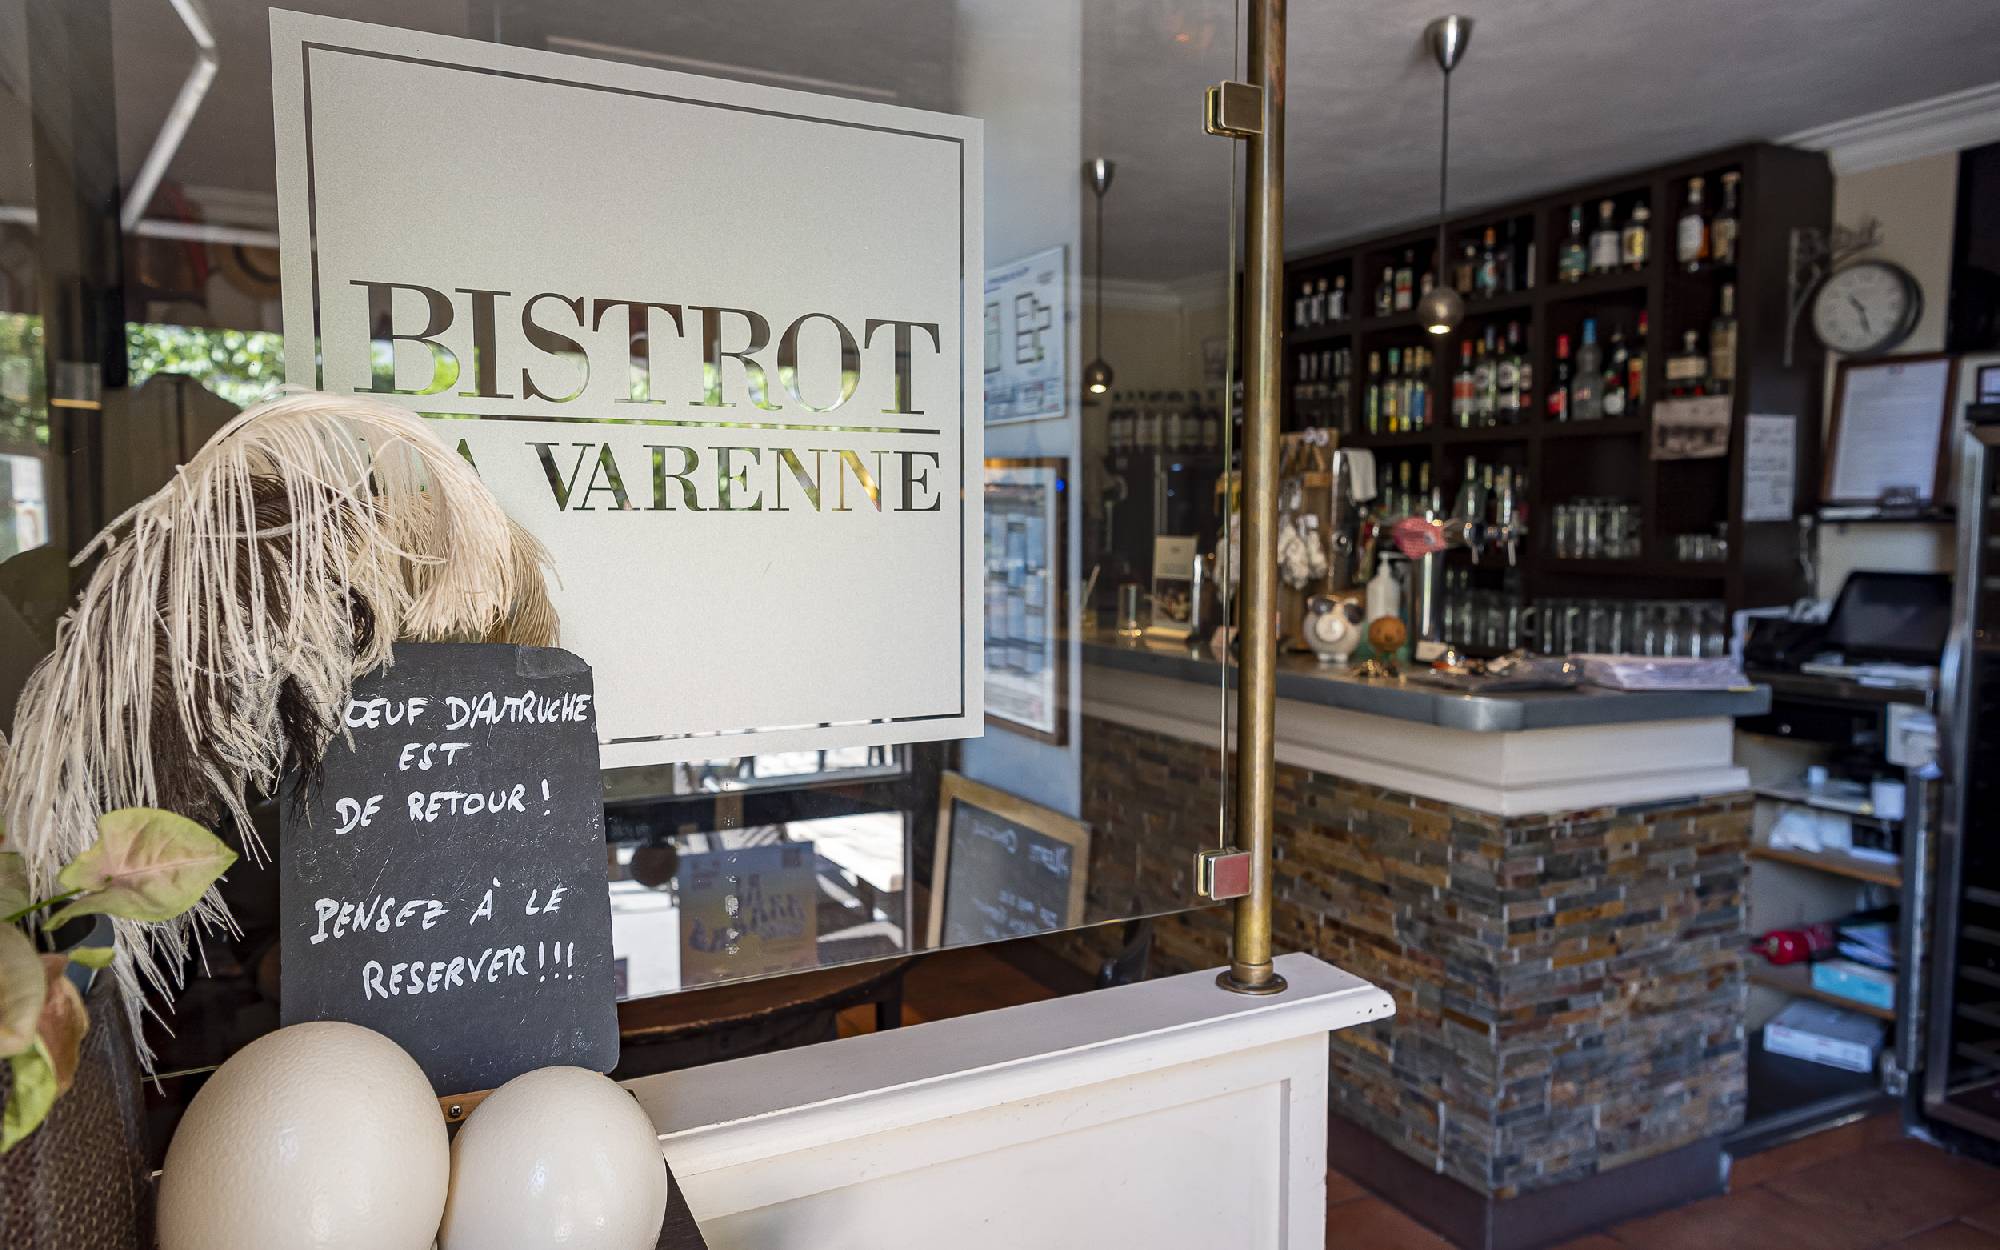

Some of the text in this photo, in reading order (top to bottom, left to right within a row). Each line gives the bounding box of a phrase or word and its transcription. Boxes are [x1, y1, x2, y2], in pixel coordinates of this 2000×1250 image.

[349, 279, 940, 415] BISTROT
[525, 441, 941, 512] VARENNE
[445, 690, 592, 731] D'AUTRUCHE
[399, 742, 472, 771] EST
[335, 794, 384, 835] DE
[310, 876, 568, 944] PENSEZ À LE
